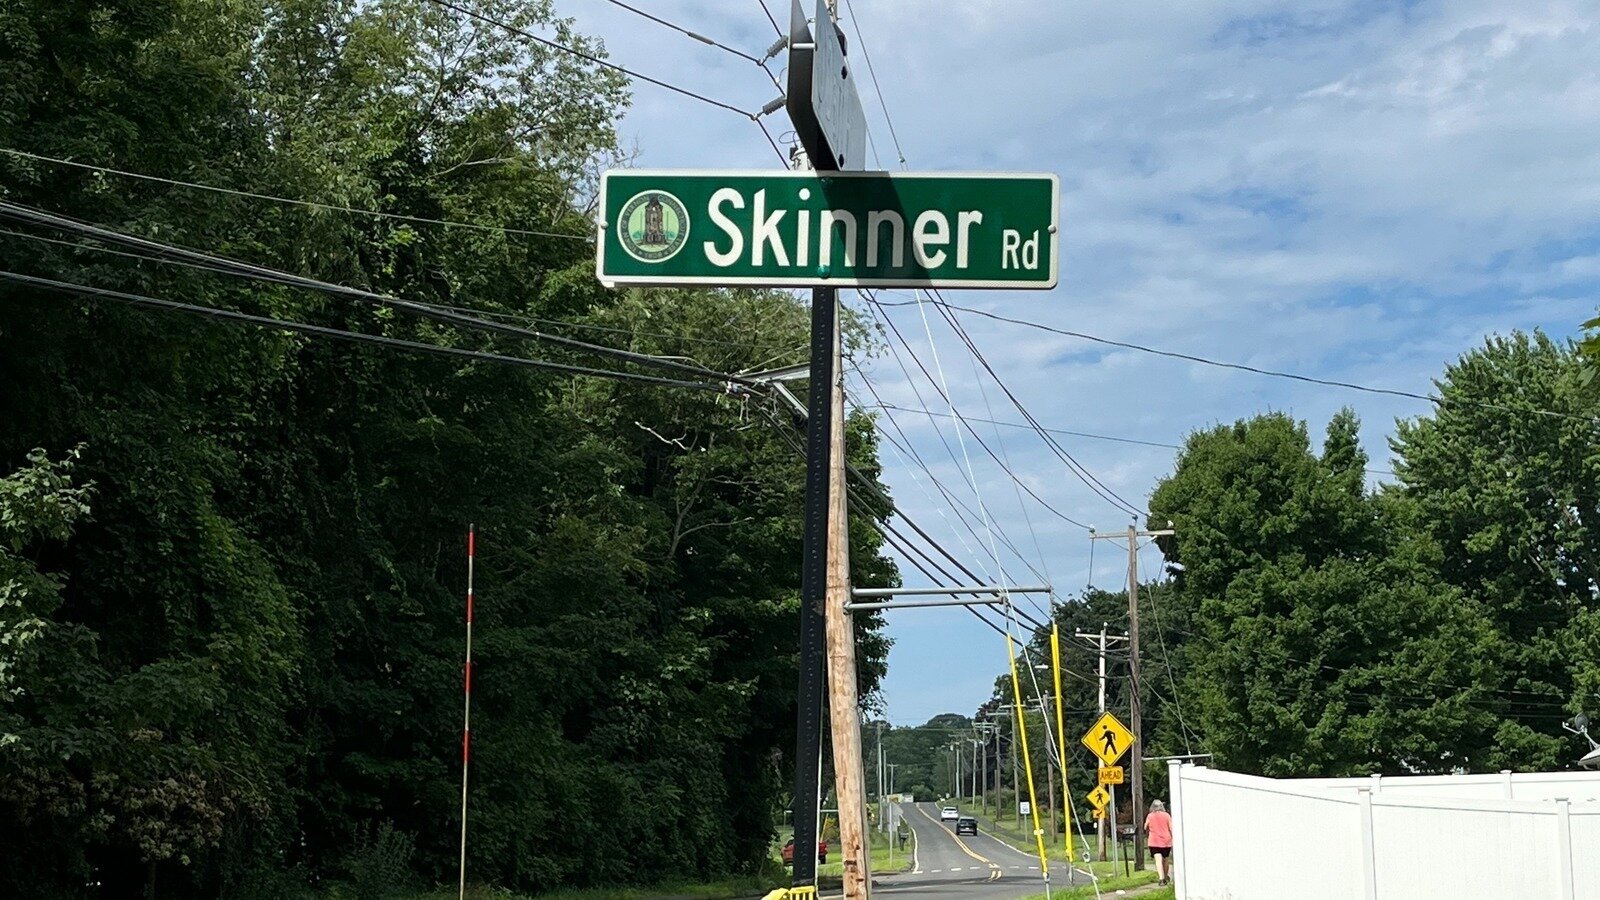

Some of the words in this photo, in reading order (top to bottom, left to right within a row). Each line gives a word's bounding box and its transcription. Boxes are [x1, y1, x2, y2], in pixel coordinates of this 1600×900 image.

[703, 187, 983, 270] Skinner
[1002, 229, 1039, 271] Rd
[1100, 770, 1122, 780] AHEAD
